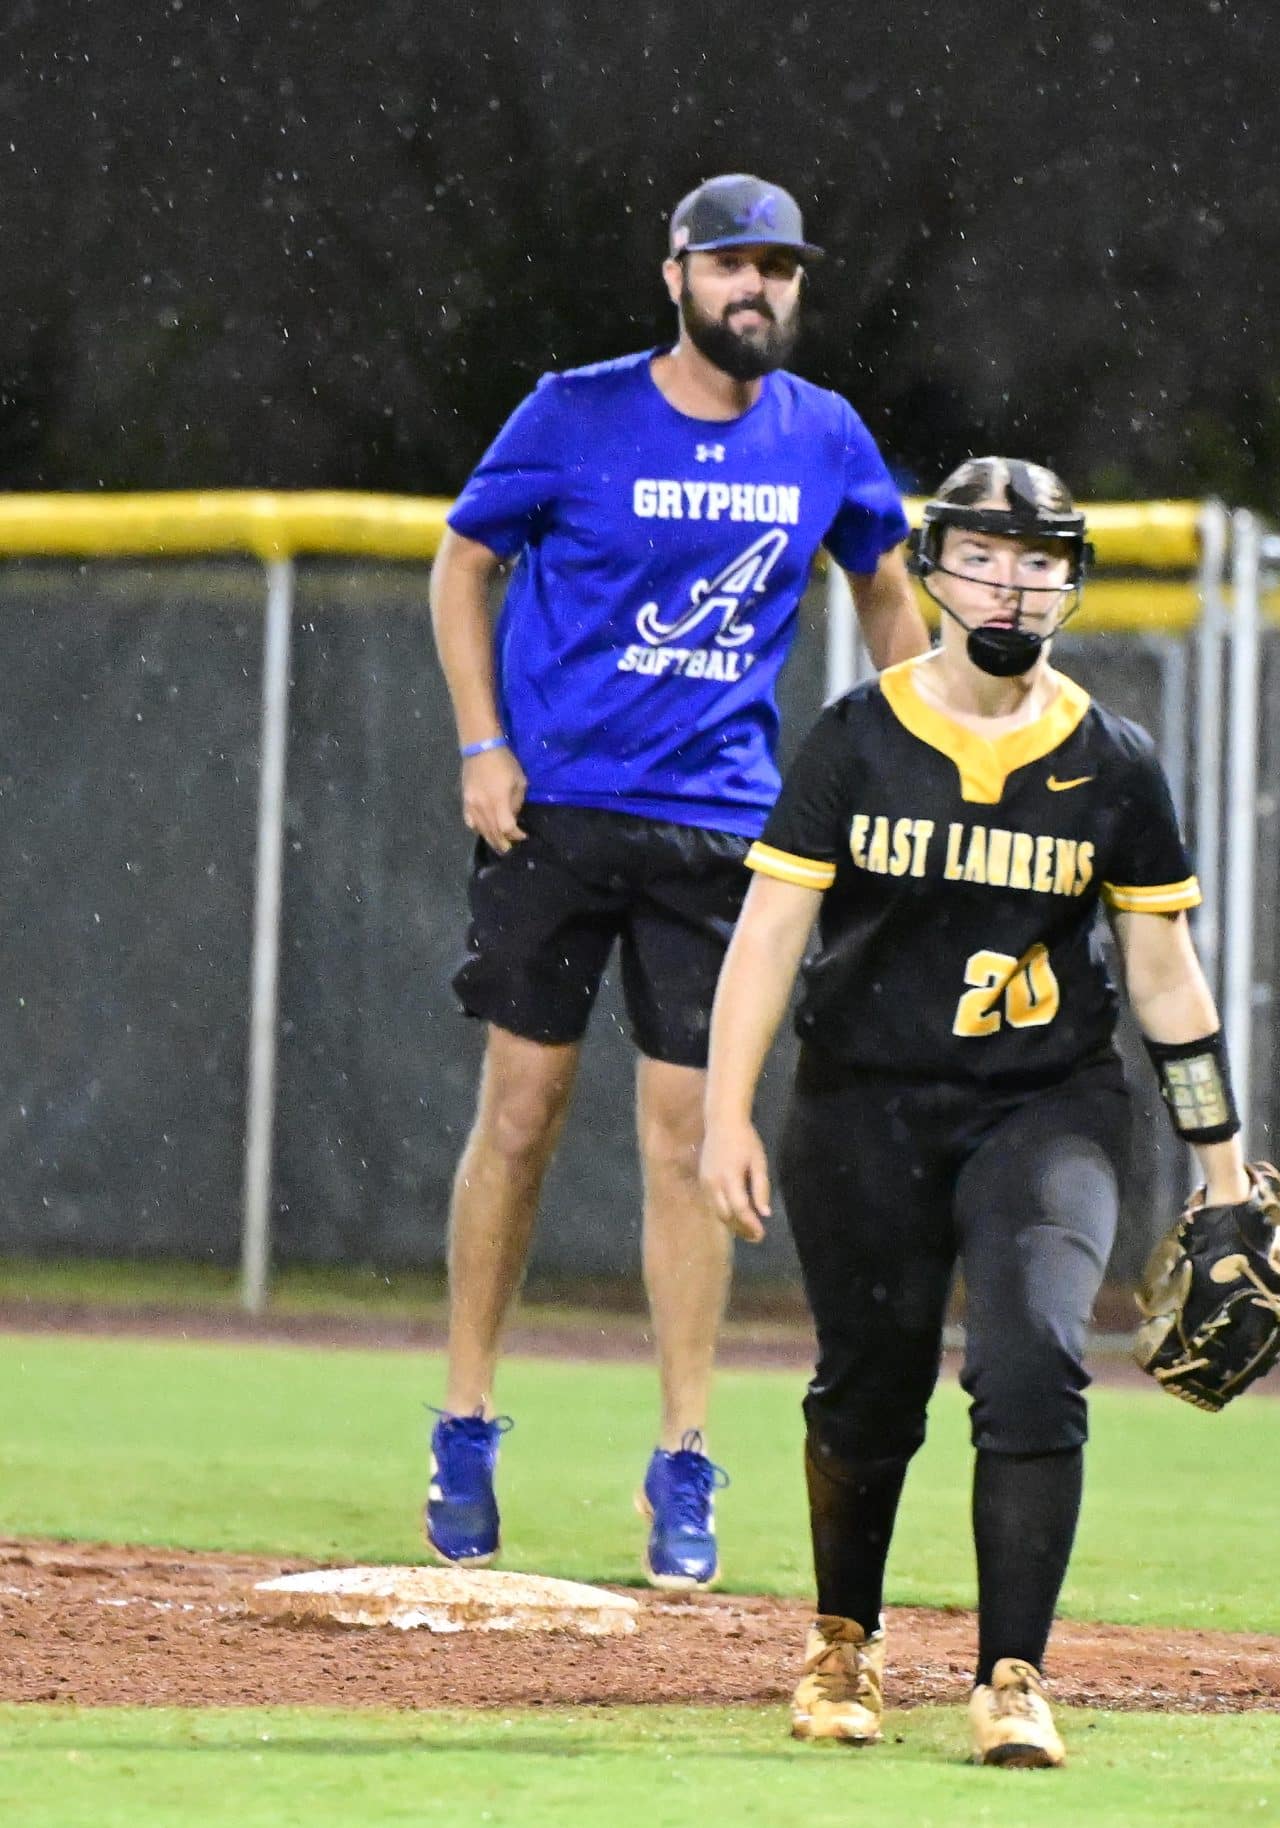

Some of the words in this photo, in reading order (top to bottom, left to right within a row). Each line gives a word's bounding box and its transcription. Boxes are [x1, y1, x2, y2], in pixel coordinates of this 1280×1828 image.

[633, 478, 800, 525] GRYPHON
[636, 528, 788, 647] A
[849, 813, 935, 878] EAST
[943, 822, 1096, 897] LAURENS
[952, 943, 1061, 1038] 20
